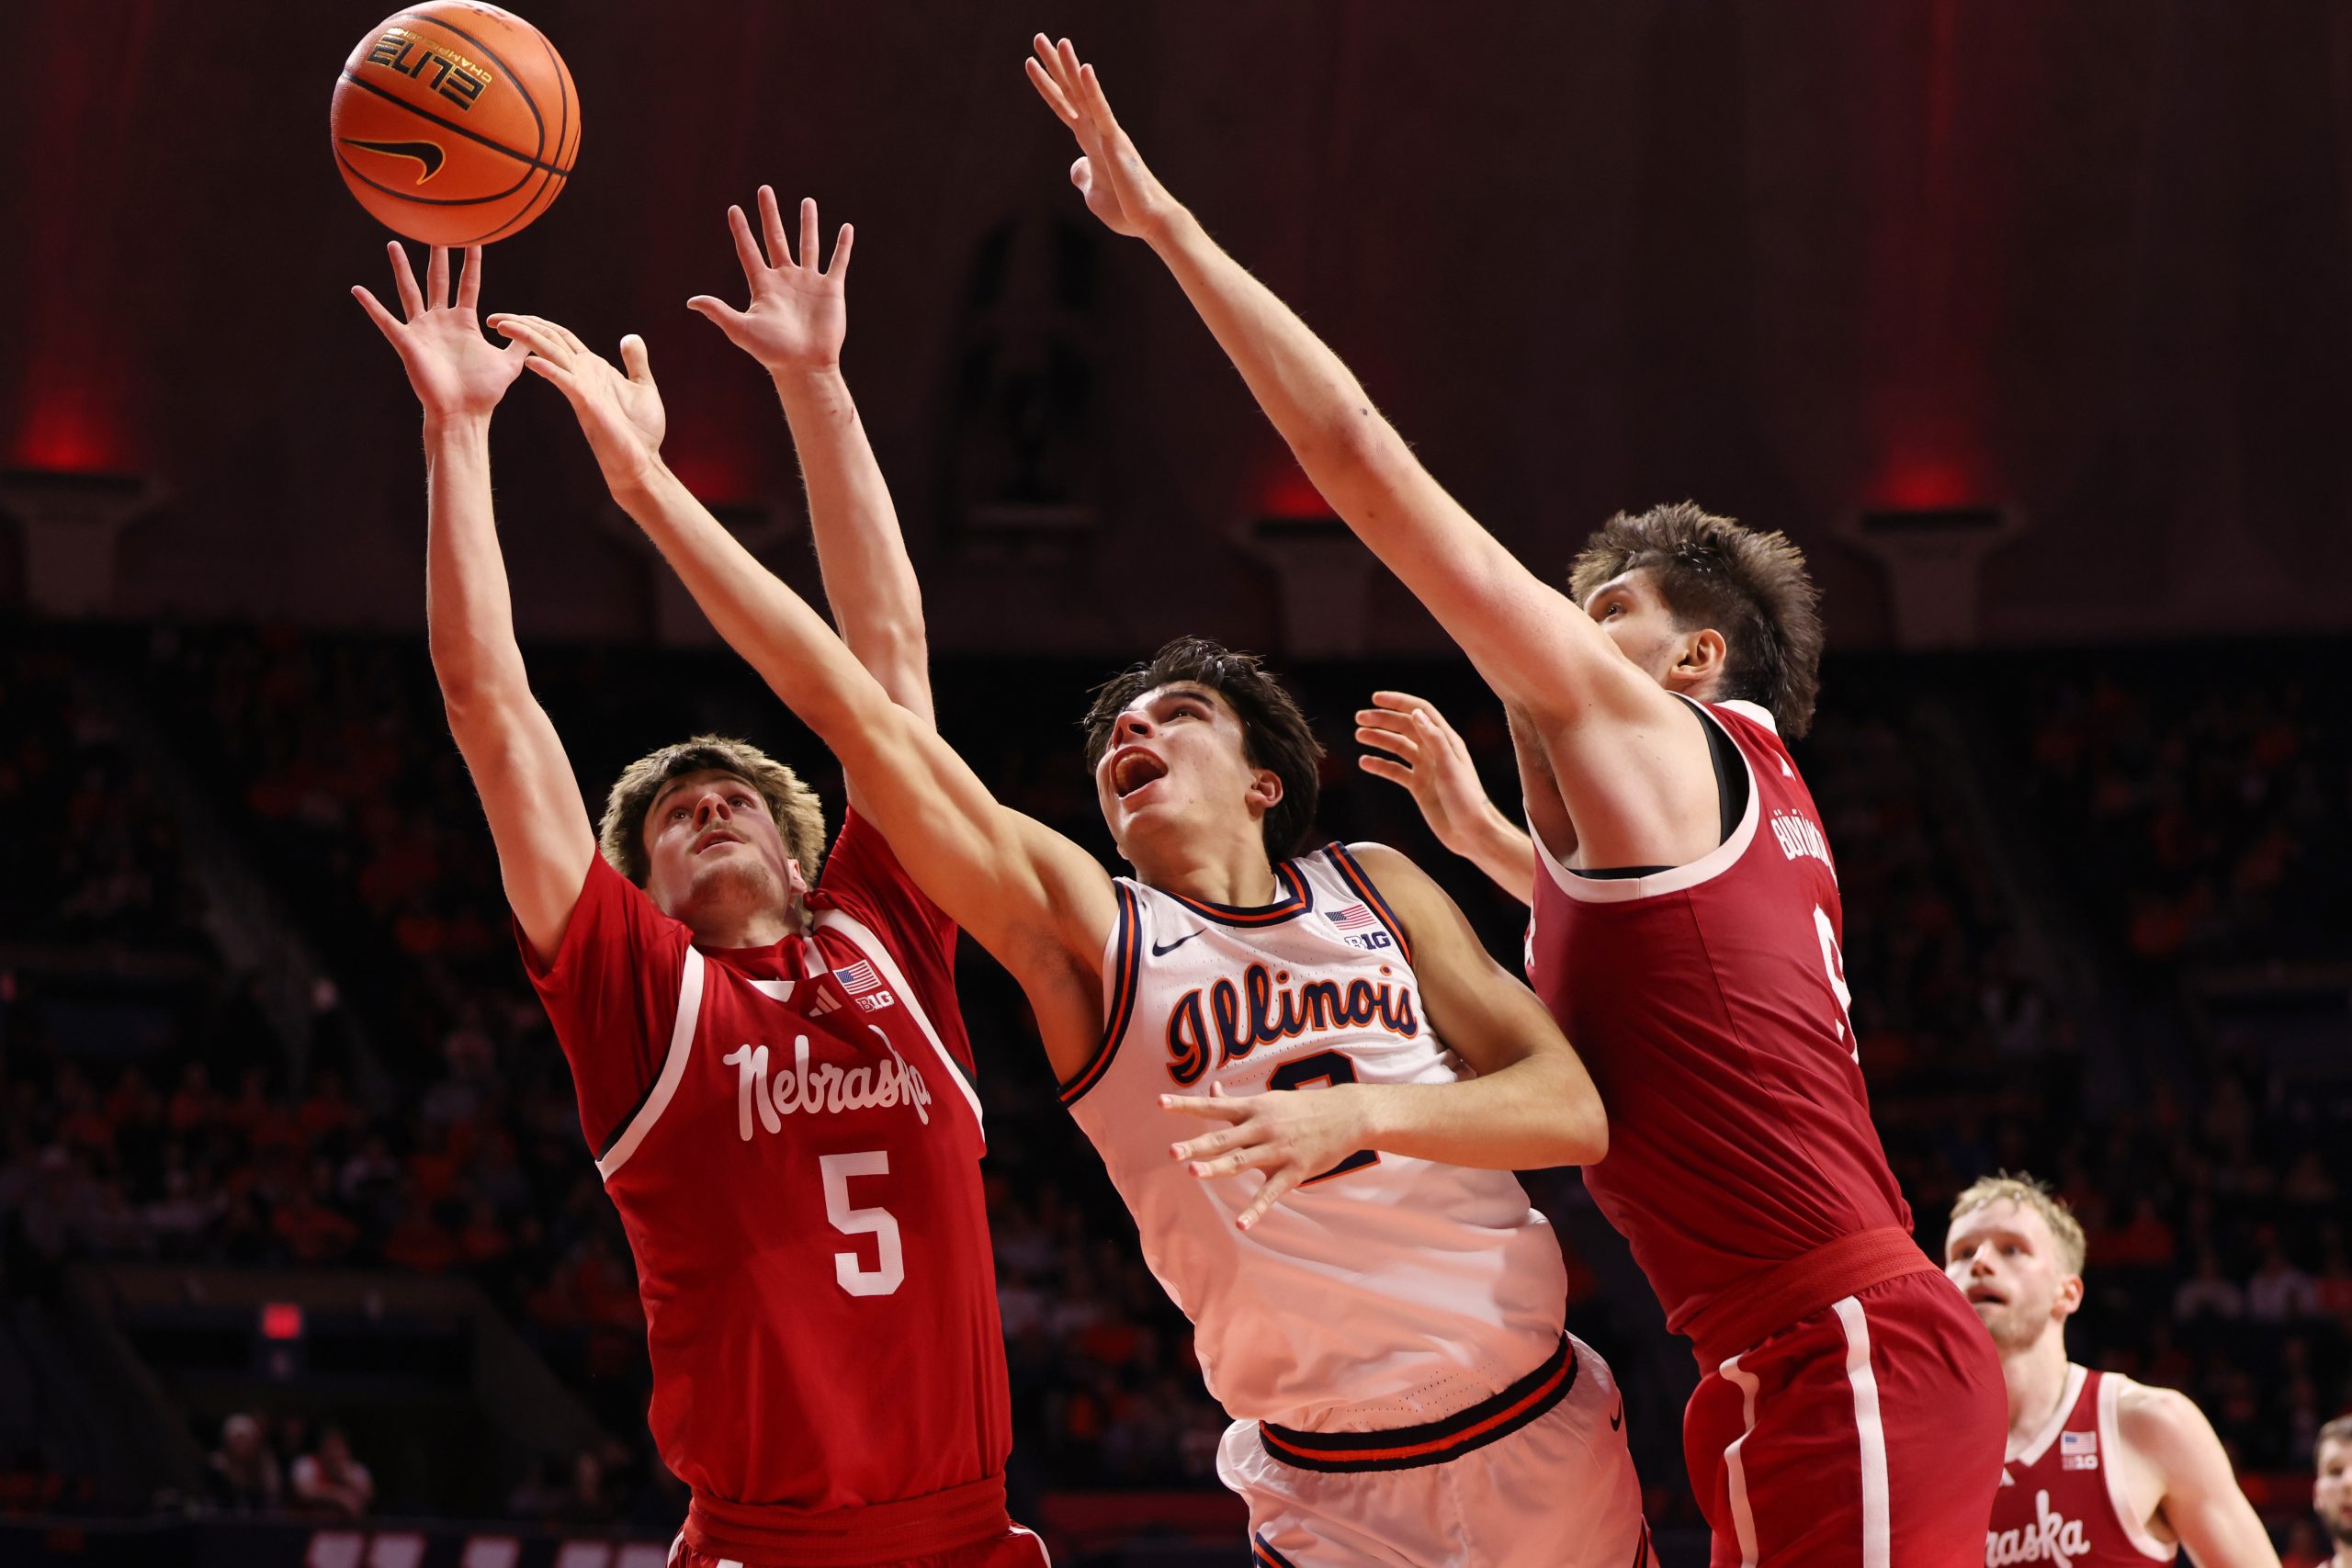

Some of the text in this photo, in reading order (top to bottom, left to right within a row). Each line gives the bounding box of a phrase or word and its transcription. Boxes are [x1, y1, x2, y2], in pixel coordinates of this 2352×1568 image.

[367, 33, 486, 111] ELITE
[722, 1024, 932, 1142] Nebraska
[1165, 961, 1419, 1089] Illinois
[819, 1150, 905, 1297] 5
